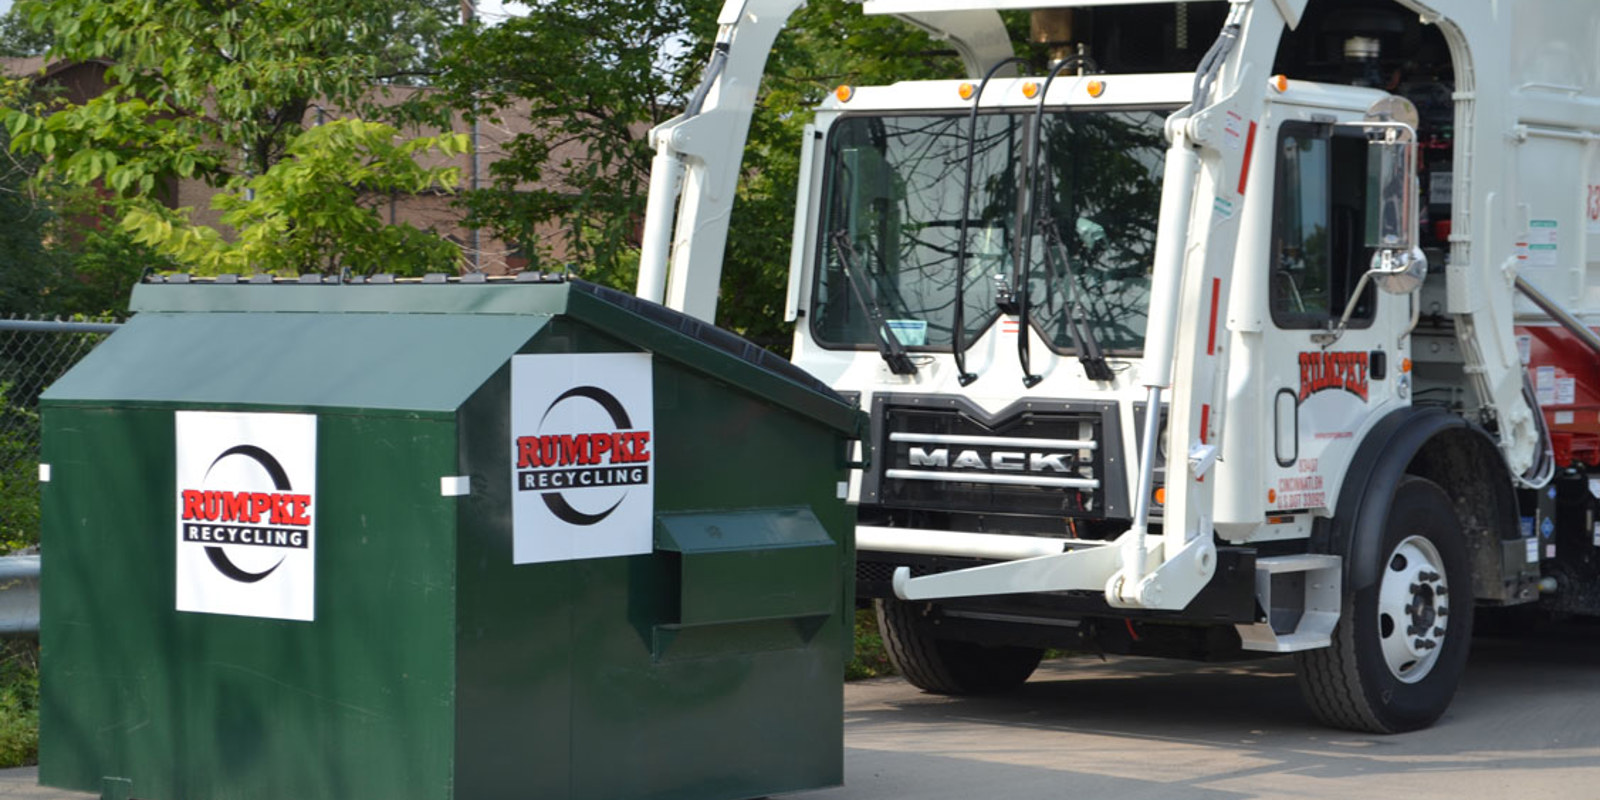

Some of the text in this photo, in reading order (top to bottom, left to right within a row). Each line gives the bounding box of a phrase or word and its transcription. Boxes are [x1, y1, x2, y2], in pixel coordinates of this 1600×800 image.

[1298, 351, 1368, 405] RUMPKE
[516, 431, 651, 469] RUMPKE
[909, 447, 1075, 473] MACK
[524, 468, 643, 488] RECYCLING
[181, 489, 312, 526] RUMPKE
[188, 526, 303, 546] RECYCLING
